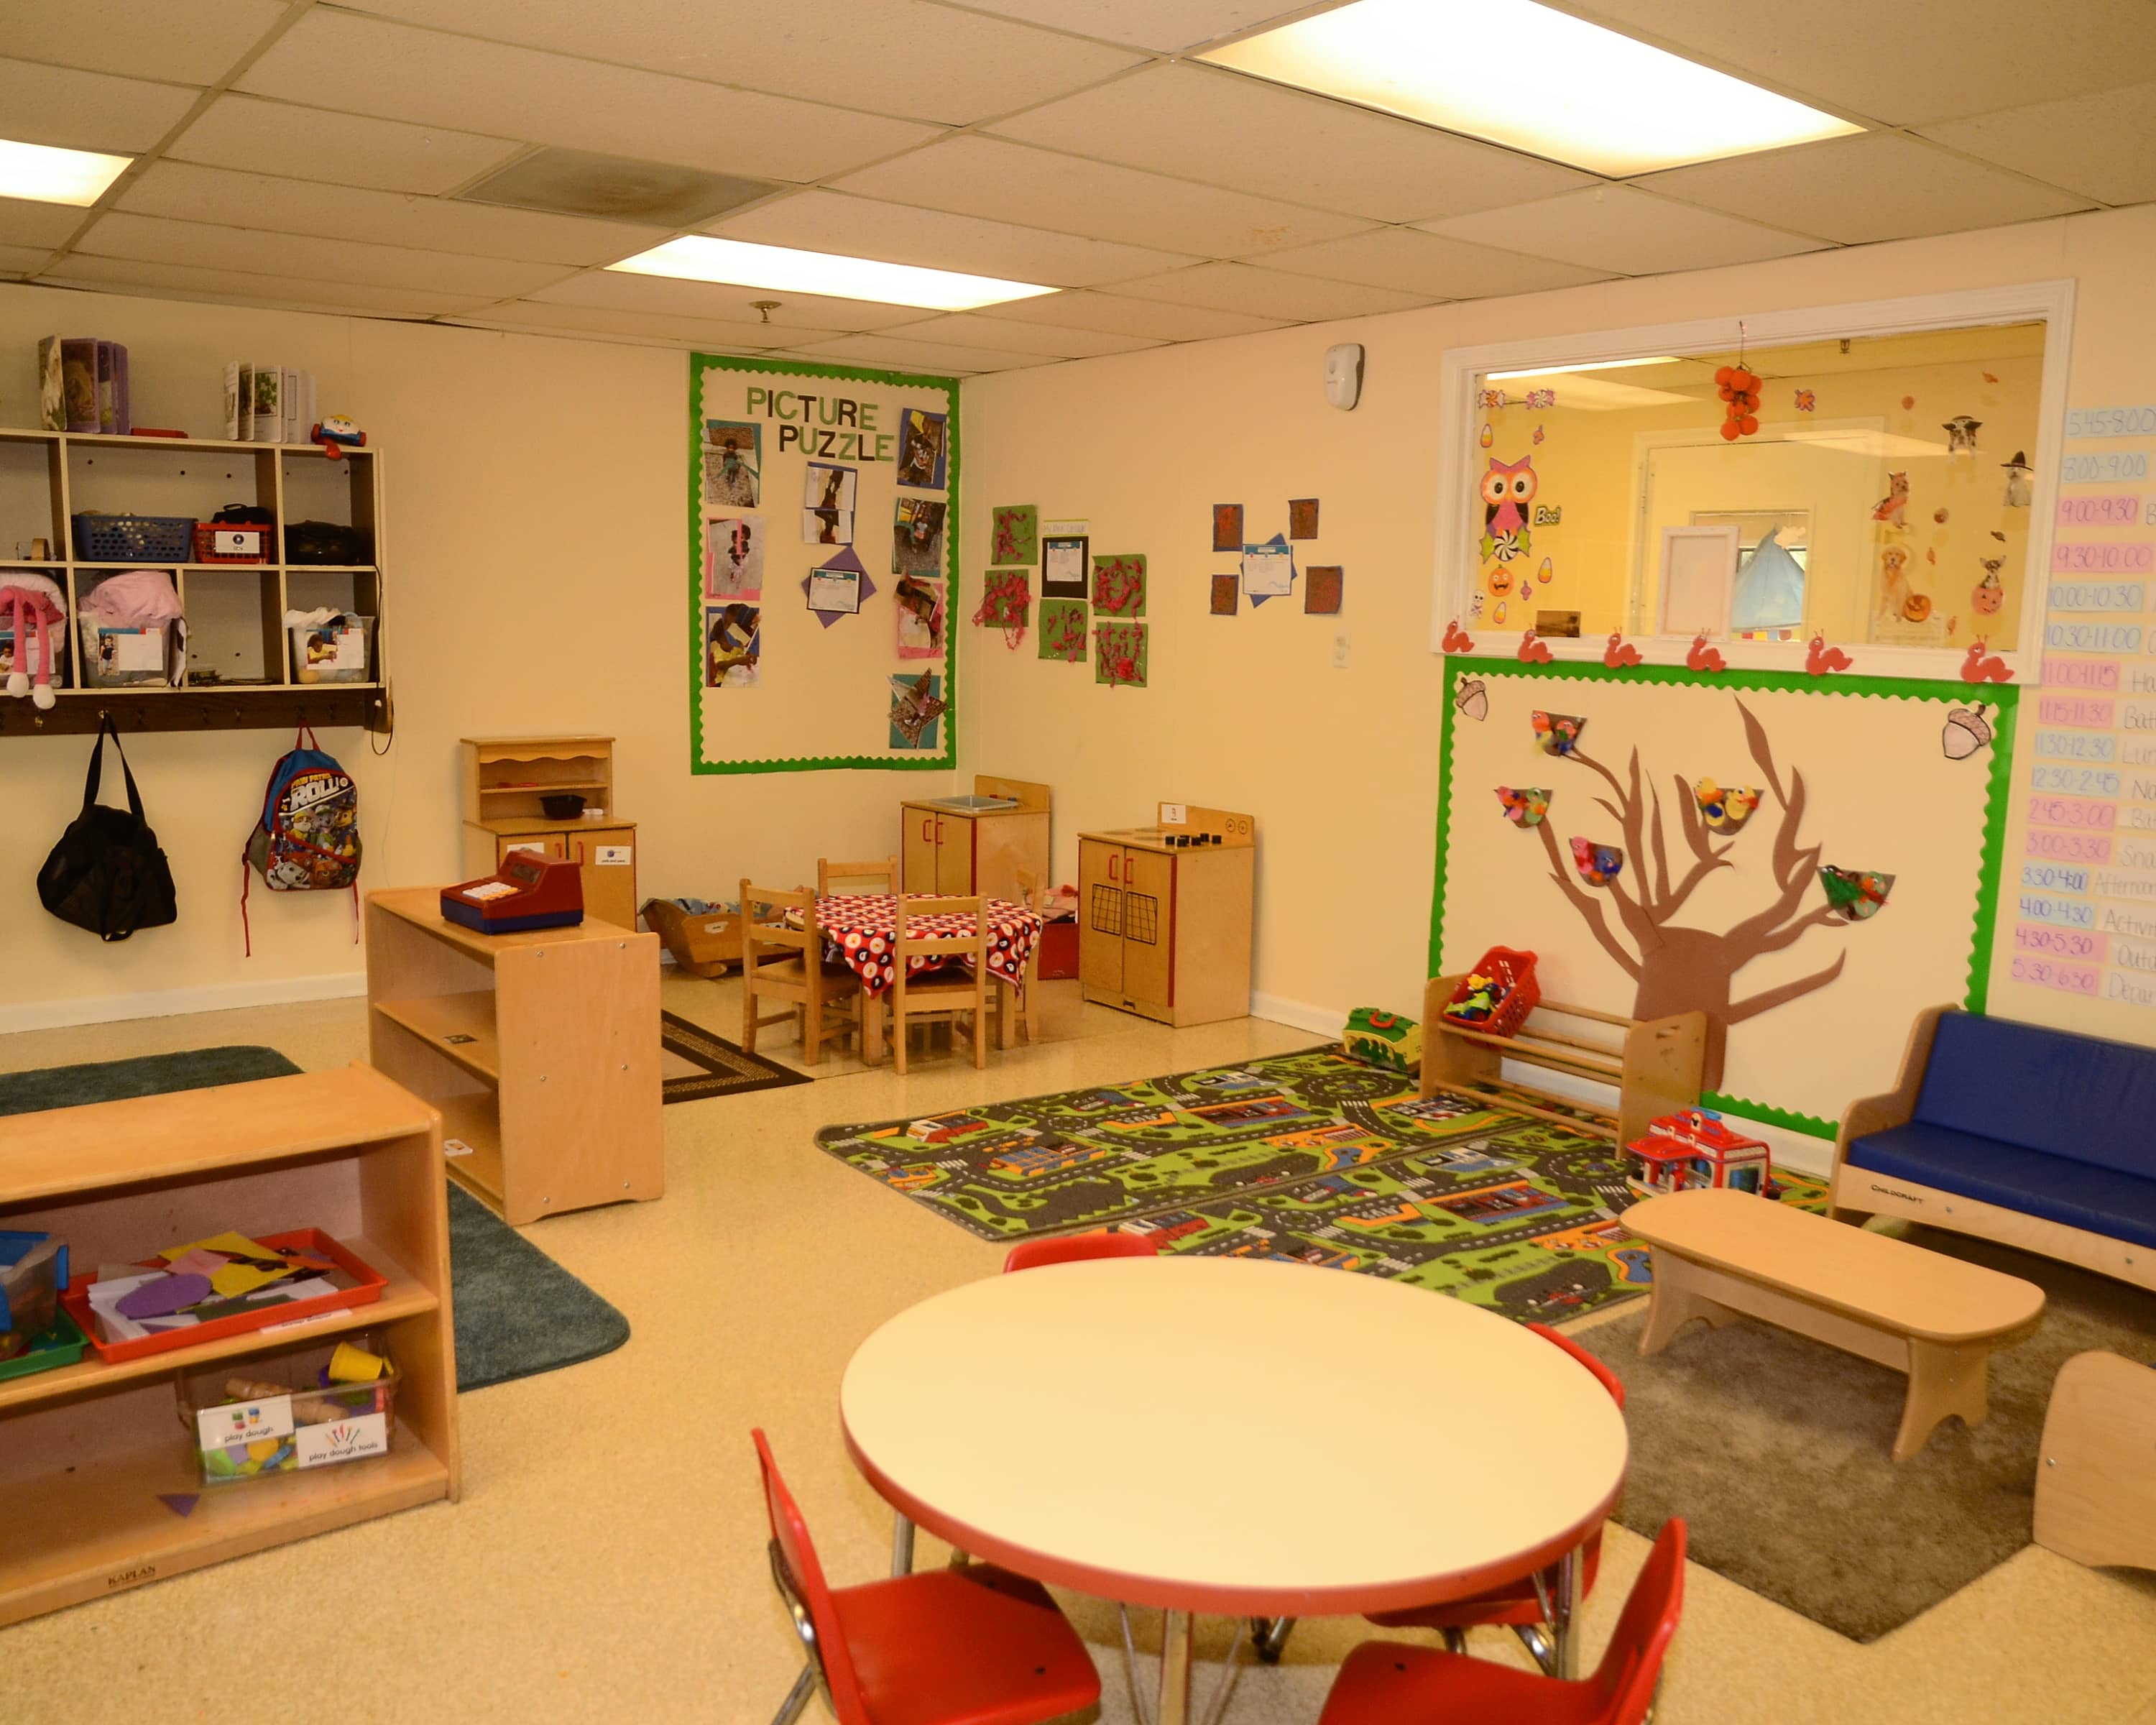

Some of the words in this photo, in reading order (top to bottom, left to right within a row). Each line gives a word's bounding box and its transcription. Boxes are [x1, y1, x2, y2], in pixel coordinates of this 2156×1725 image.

[747, 387, 879, 431] PICTURE
[779, 424, 895, 462] PUZZLE
[1534, 506, 1561, 525] Boo!
[224, 1432, 243, 1443] play
[246, 1426, 274, 1439] dough
[309, 1450, 328, 1462] play
[329, 1445, 356, 1457] dough
[359, 1442, 379, 1452] tools
